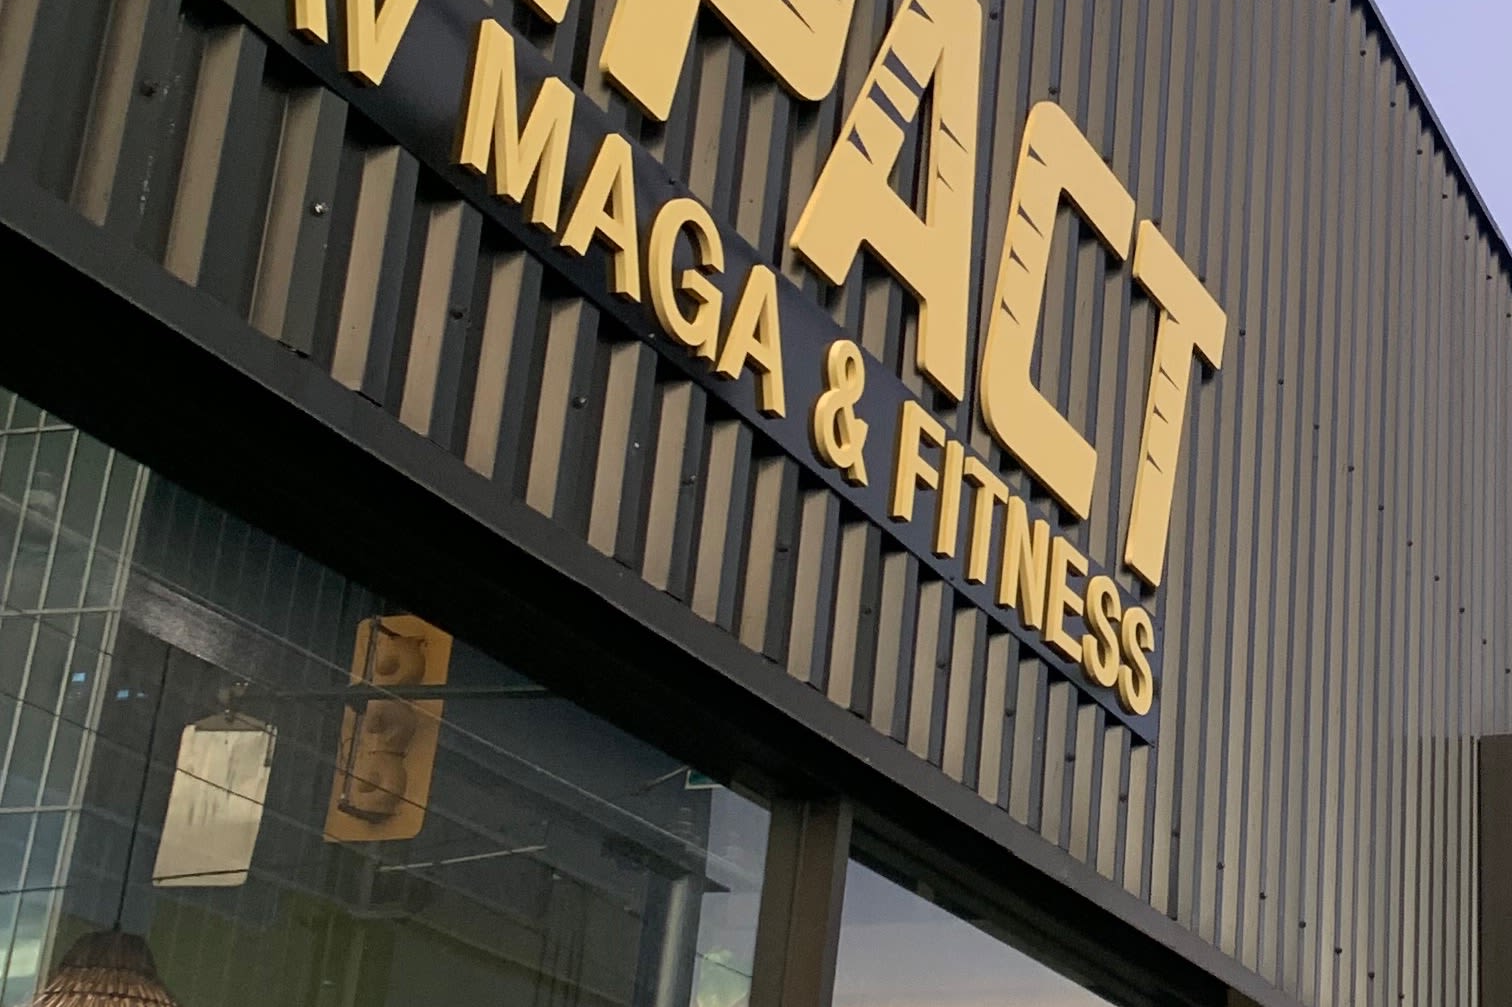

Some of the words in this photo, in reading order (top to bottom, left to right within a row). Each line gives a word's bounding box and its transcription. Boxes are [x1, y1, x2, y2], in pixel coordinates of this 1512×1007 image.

[458, 18, 786, 419] MAGA
[810, 339, 868, 486] &
[888, 399, 1156, 716] FITNESS
